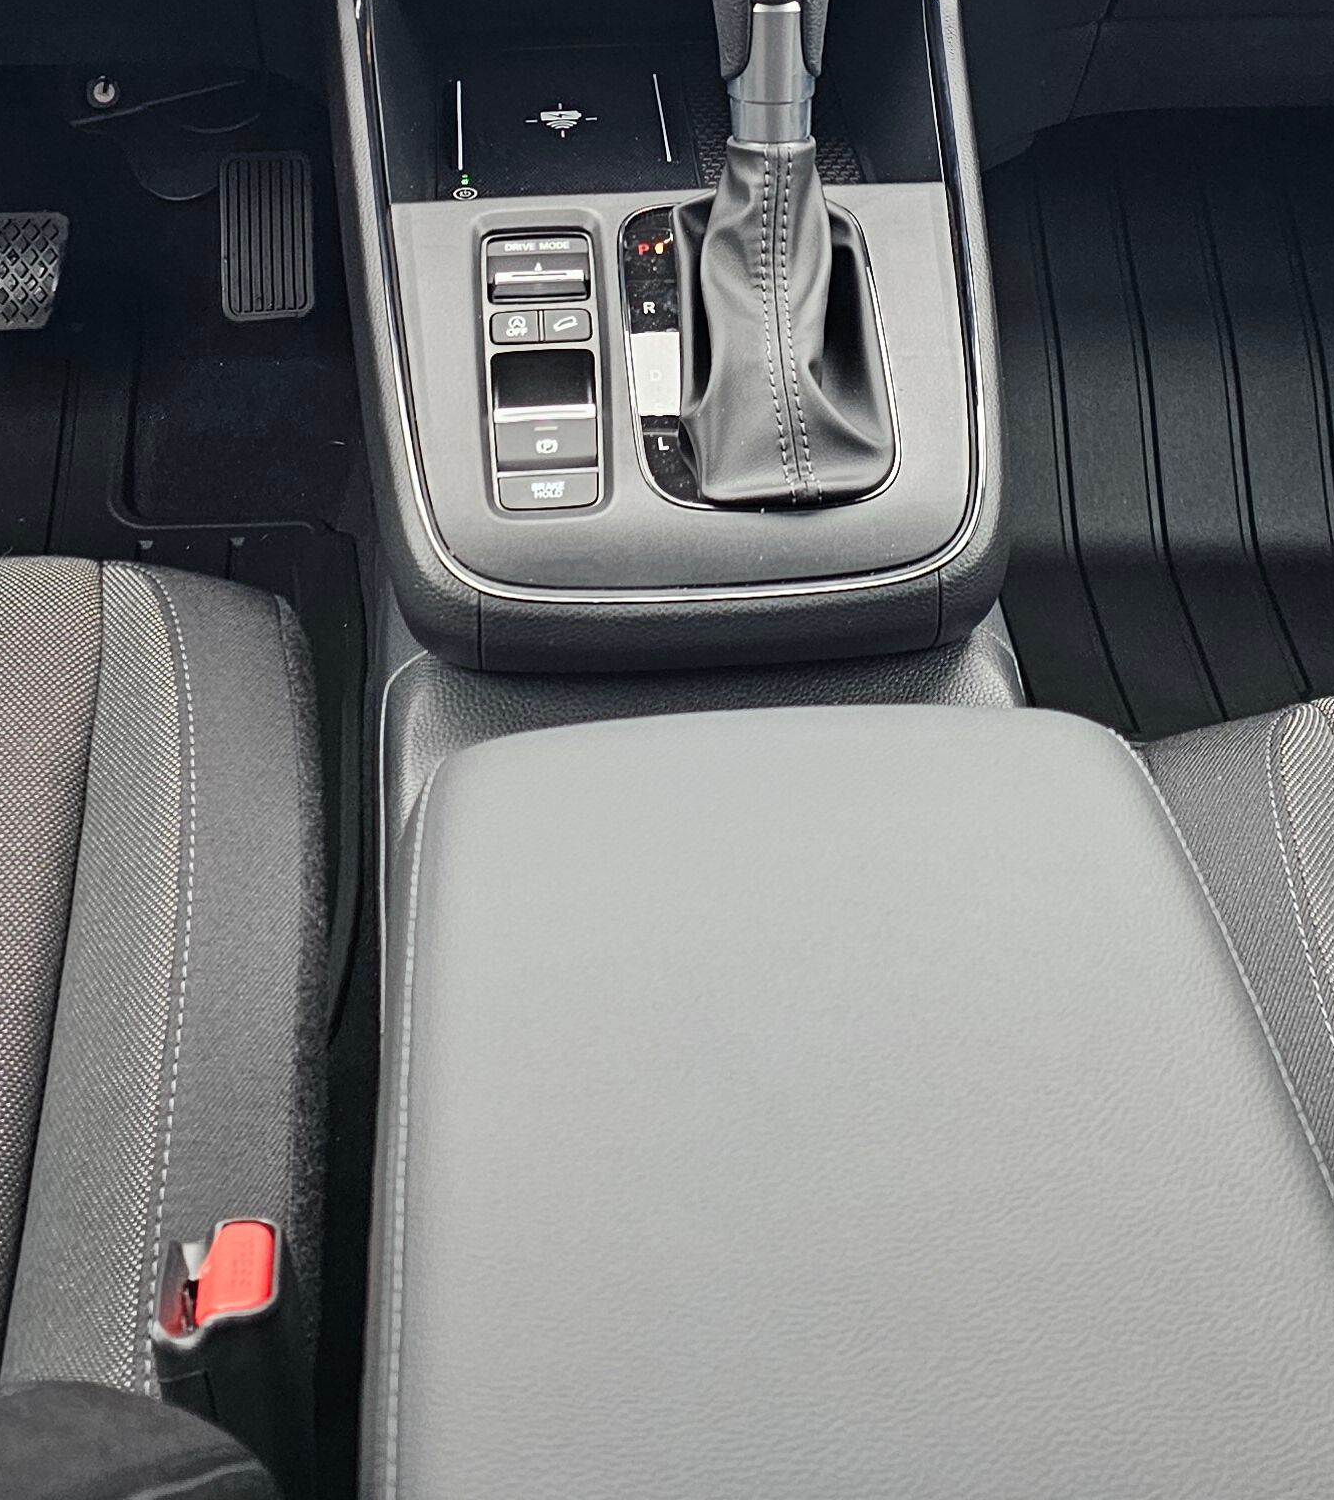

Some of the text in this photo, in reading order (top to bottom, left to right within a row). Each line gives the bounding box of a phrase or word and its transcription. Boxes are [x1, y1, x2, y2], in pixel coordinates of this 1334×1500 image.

[504, 241, 570, 252] DRIVE MODE
[638, 244, 649, 256] P
[643, 302, 656, 315] R
[506, 328, 528, 337] OFF
[650, 370, 662, 382] D
[657, 436, 669, 451] L
[531, 481, 565, 491] BRAKE
[534, 490, 563, 499] HOLD
